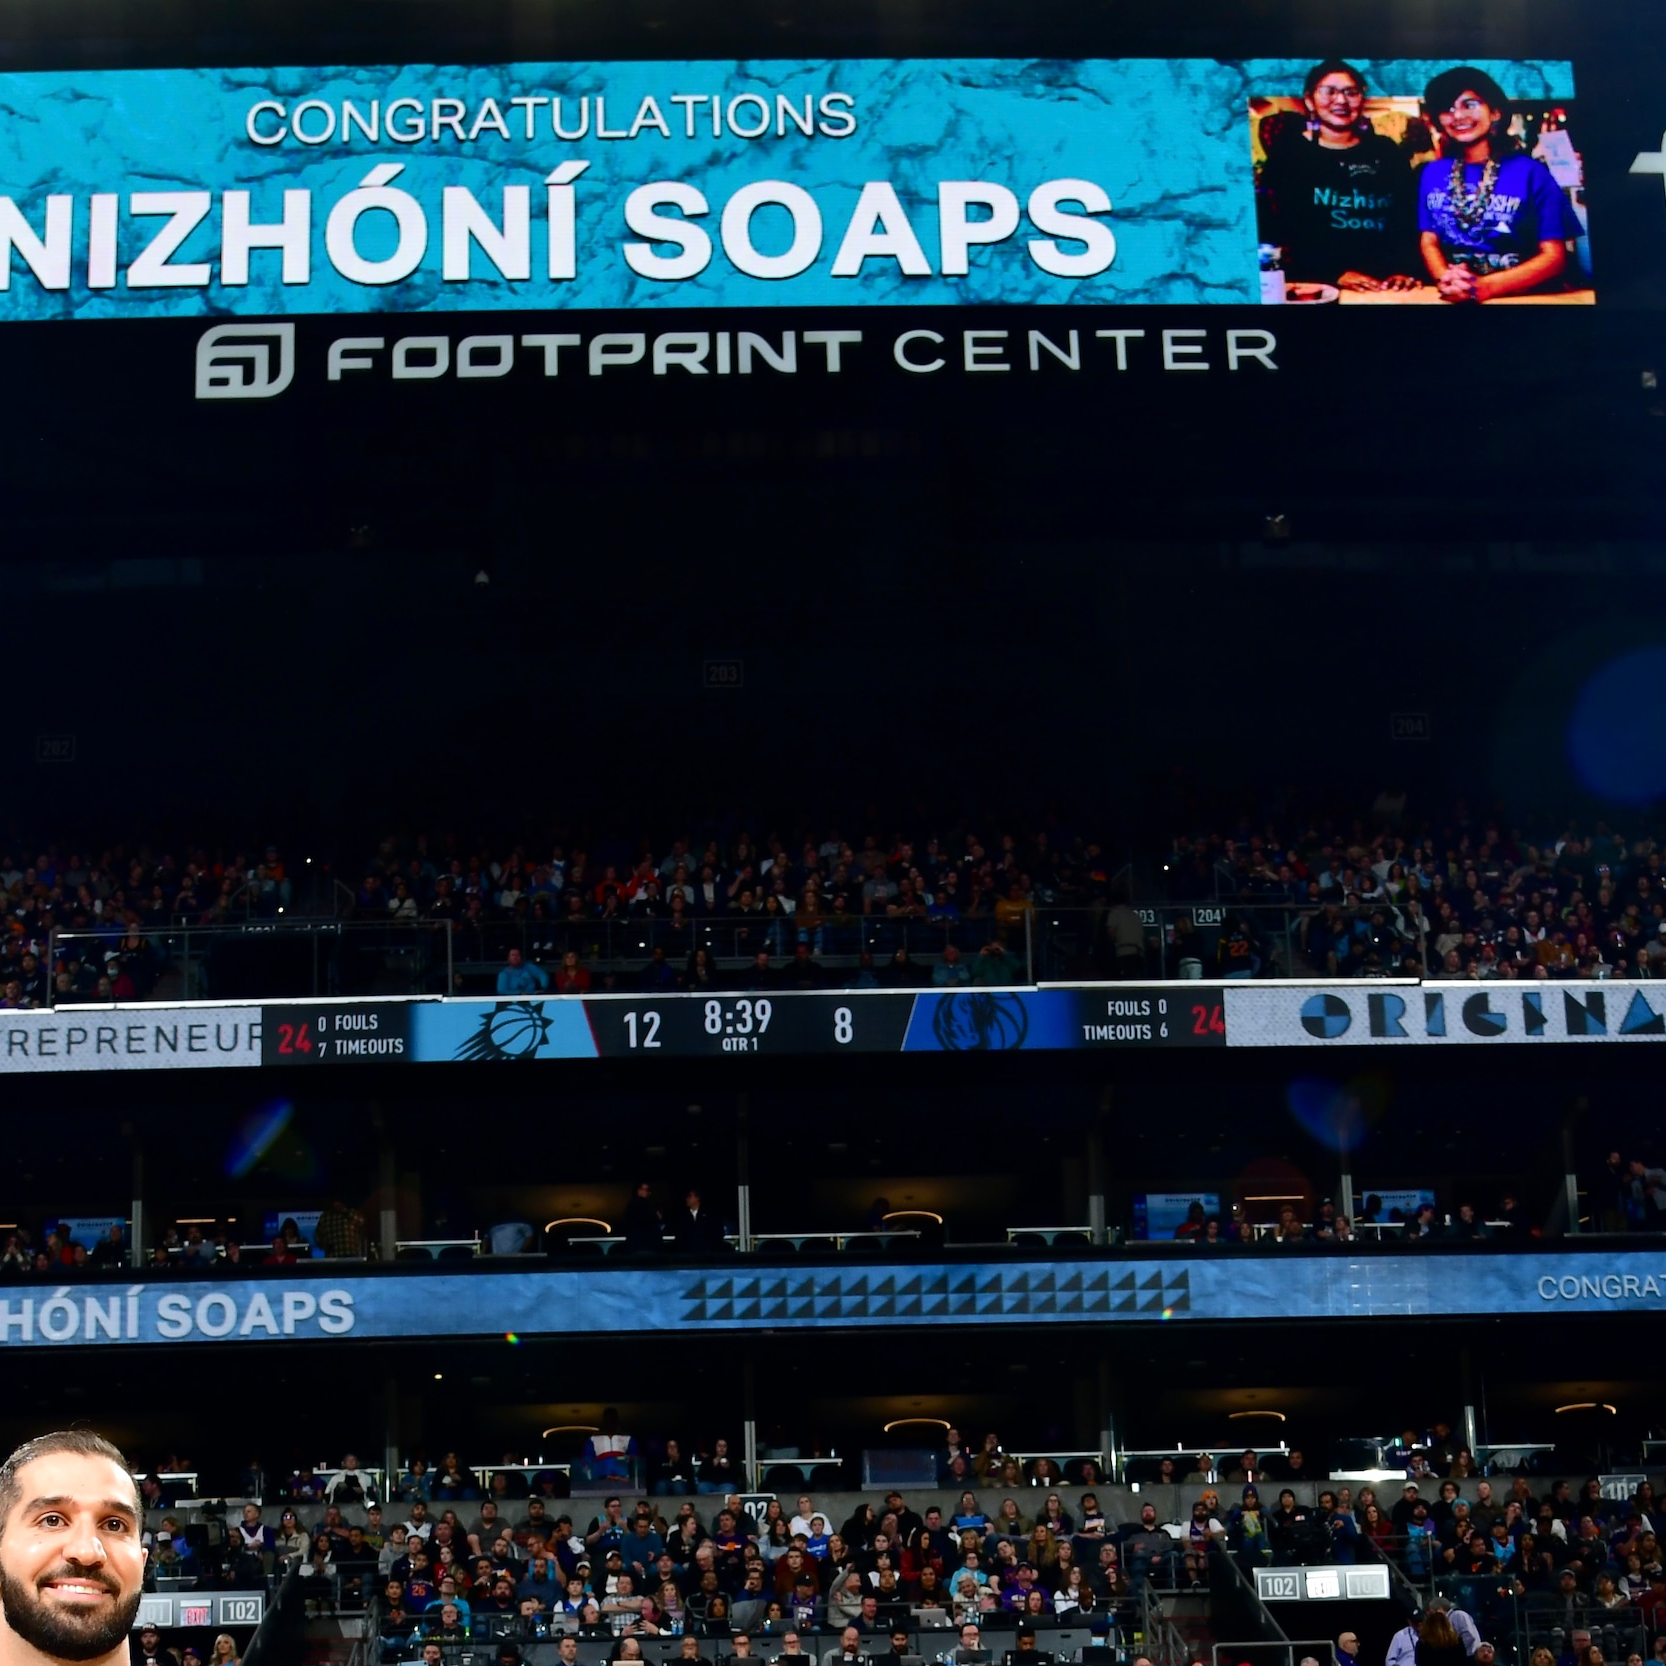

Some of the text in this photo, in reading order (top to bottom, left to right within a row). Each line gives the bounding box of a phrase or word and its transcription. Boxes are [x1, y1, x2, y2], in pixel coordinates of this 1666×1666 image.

[245, 91, 858, 147] CONGRATULATIONS
[621, 175, 1119, 282] SOAPS
[327, 326, 1281, 384] FOOTPRINT CENTER
[1196, 908, 1223, 923] 204
[703, 998, 773, 1036] 8:39
[1107, 998, 1167, 1018] FOULS 0
[1192, 1004, 1225, 1036] 24
[317, 1012, 379, 1032] 0 FOULS
[623, 1011, 661, 1049] 12
[833, 1007, 853, 1044] 8
[1083, 1022, 1169, 1042] TIMEOUTS 6
[277, 1023, 313, 1055] 24
[317, 1035, 404, 1057] 7 TIMEOUTS
[722, 1036, 759, 1053] QTR 1
[156, 1289, 356, 1338] SOAPS
[1265, 1577, 1294, 1596] 102
[186, 1607, 209, 1626] EXIT
[227, 1602, 256, 1620] 102
